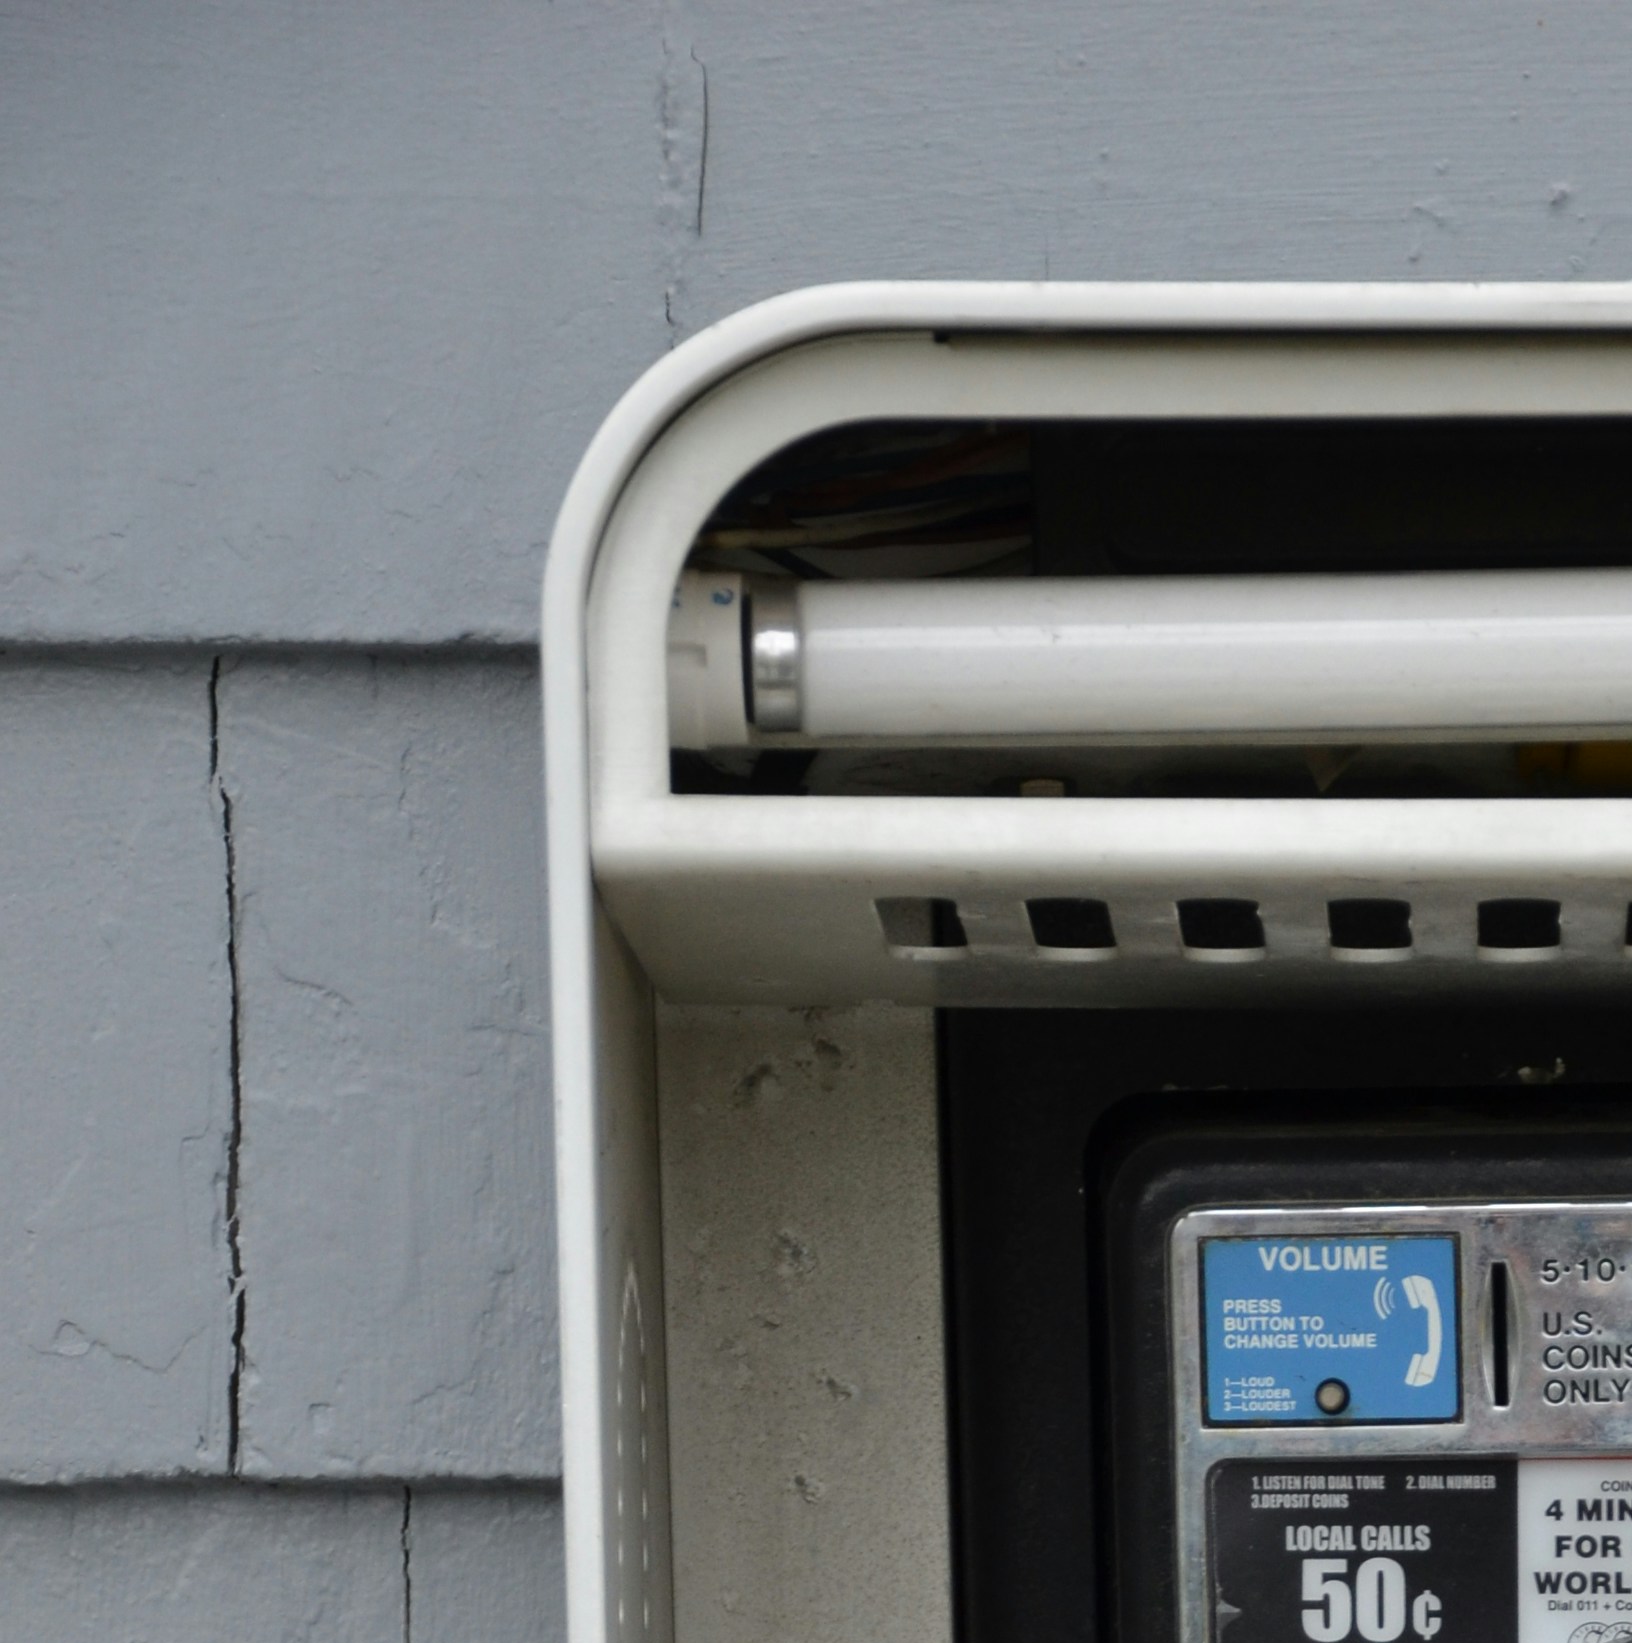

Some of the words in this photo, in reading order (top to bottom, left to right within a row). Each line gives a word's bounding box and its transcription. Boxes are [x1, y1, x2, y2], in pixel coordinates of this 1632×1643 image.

[1258, 1245, 1389, 1273] VOLUME
[1222, 1299, 1282, 1315] PRESS
[1223, 1316, 1297, 1333] BUTTON
[1299, 1316, 1325, 1332] TO
[1542, 1311, 1603, 1336] U.S.
[1223, 1333, 1299, 1349] CHANGE
[1303, 1332, 1378, 1348] VOLUME
[1542, 1378, 1632, 1405] ONLY
[1252, 1477, 1261, 1489] 1.
[1263, 1476, 1300, 1490] LISTEN
[1303, 1476, 1325, 1489] FOR
[1328, 1476, 1353, 1489] DIAL
[1355, 1475, 1385, 1489] TONE
[1405, 1475, 1417, 1489] 2.
[1418, 1475, 1445, 1489] DIAL
[1446, 1475, 1496, 1489] NUMBER
[1312, 1493, 1349, 1508] COINS
[1545, 1499, 1564, 1522] 4
[1285, 1525, 1356, 1551] LOCAL
[1360, 1524, 1431, 1551] CALLS
[1554, 1534, 1622, 1558] FOR
[1547, 1600, 1572, 1612] Dial
[1576, 1600, 1598, 1611] 011
